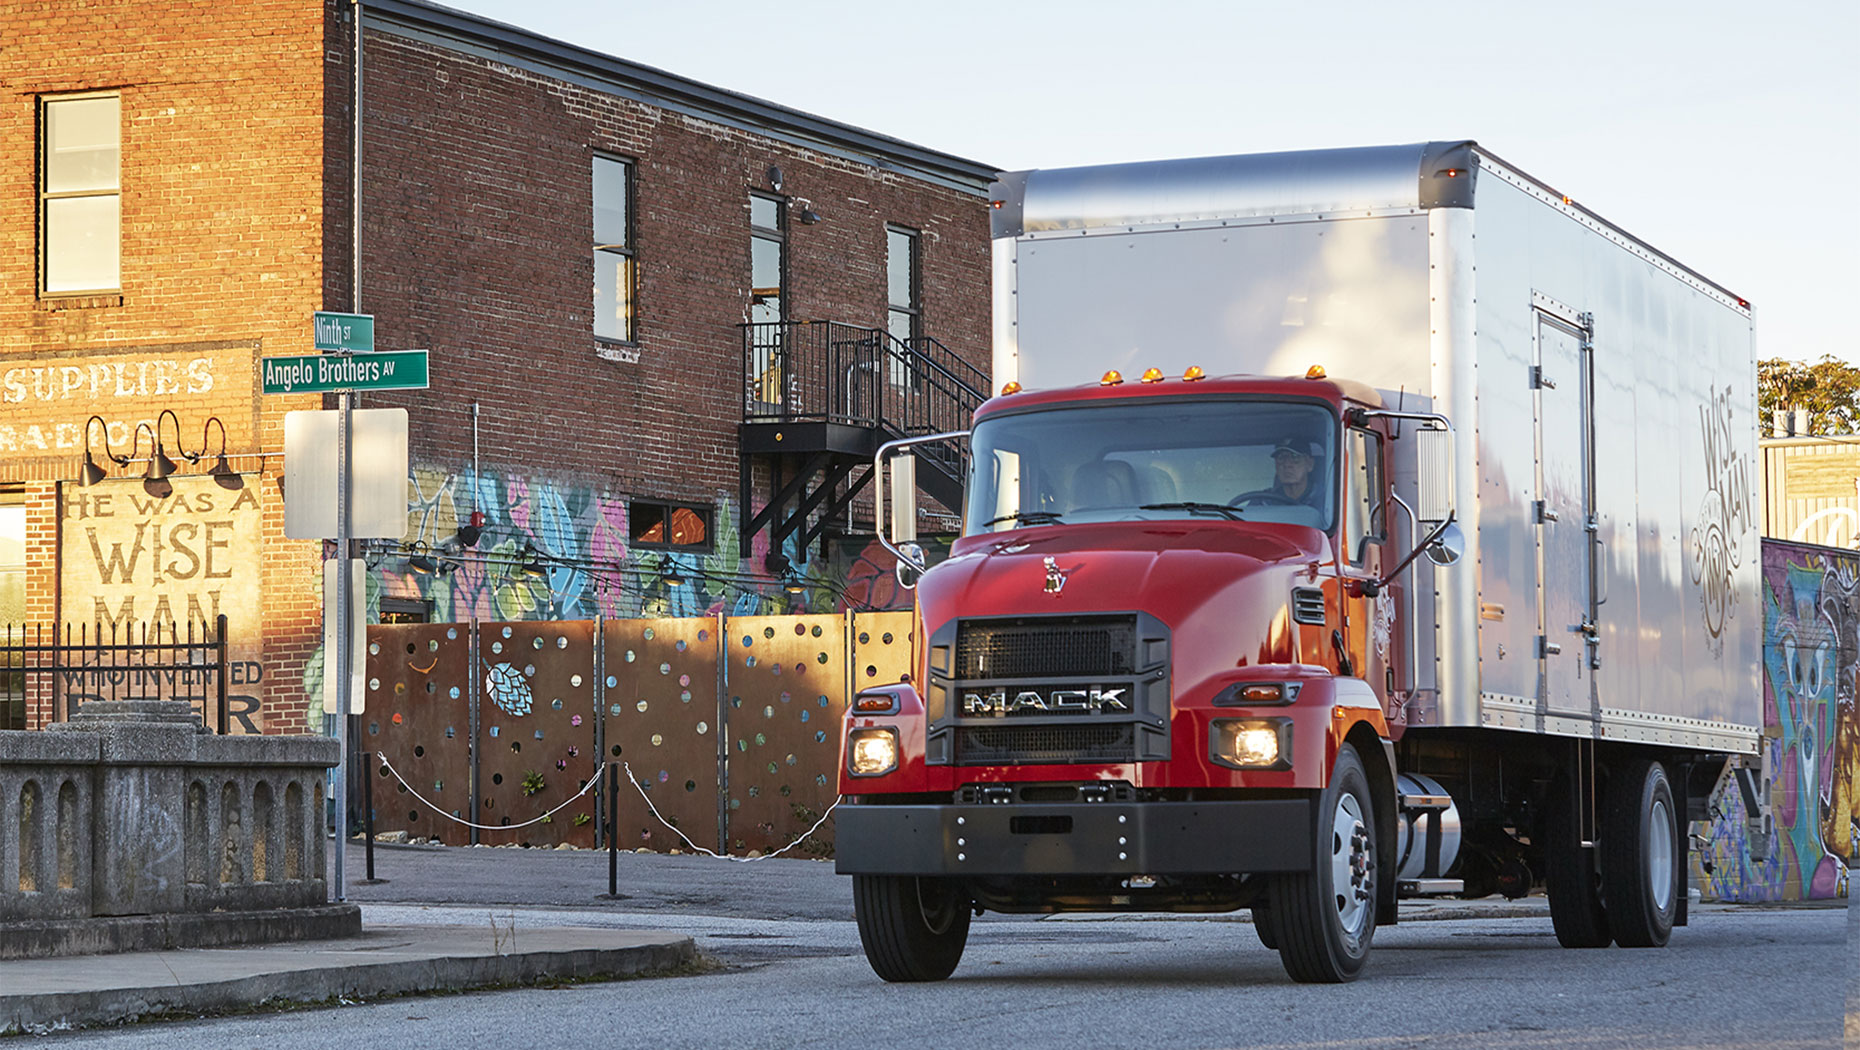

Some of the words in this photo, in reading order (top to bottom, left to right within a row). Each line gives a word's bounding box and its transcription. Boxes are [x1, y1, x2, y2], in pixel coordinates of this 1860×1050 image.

[316, 317, 342, 345] Ninth
[343, 326, 352, 340] ST
[3, 357, 215, 403] SUPPLIES
[266, 359, 313, 392] Angelo
[319, 357, 379, 383] Brothers
[383, 361, 395, 376] AV
[1699, 384, 1737, 491] WISE
[62, 493, 115, 520] HE
[128, 493, 215, 515] WAS
[229, 488, 262, 513] A
[1719, 453, 1752, 565] MAN
[85, 519, 234, 587] WISE
[86, 588, 222, 660] MAN
[58, 664, 126, 687] WHO
[134, 661, 263, 686] INVENED
[964, 689, 1127, 712] MACK
